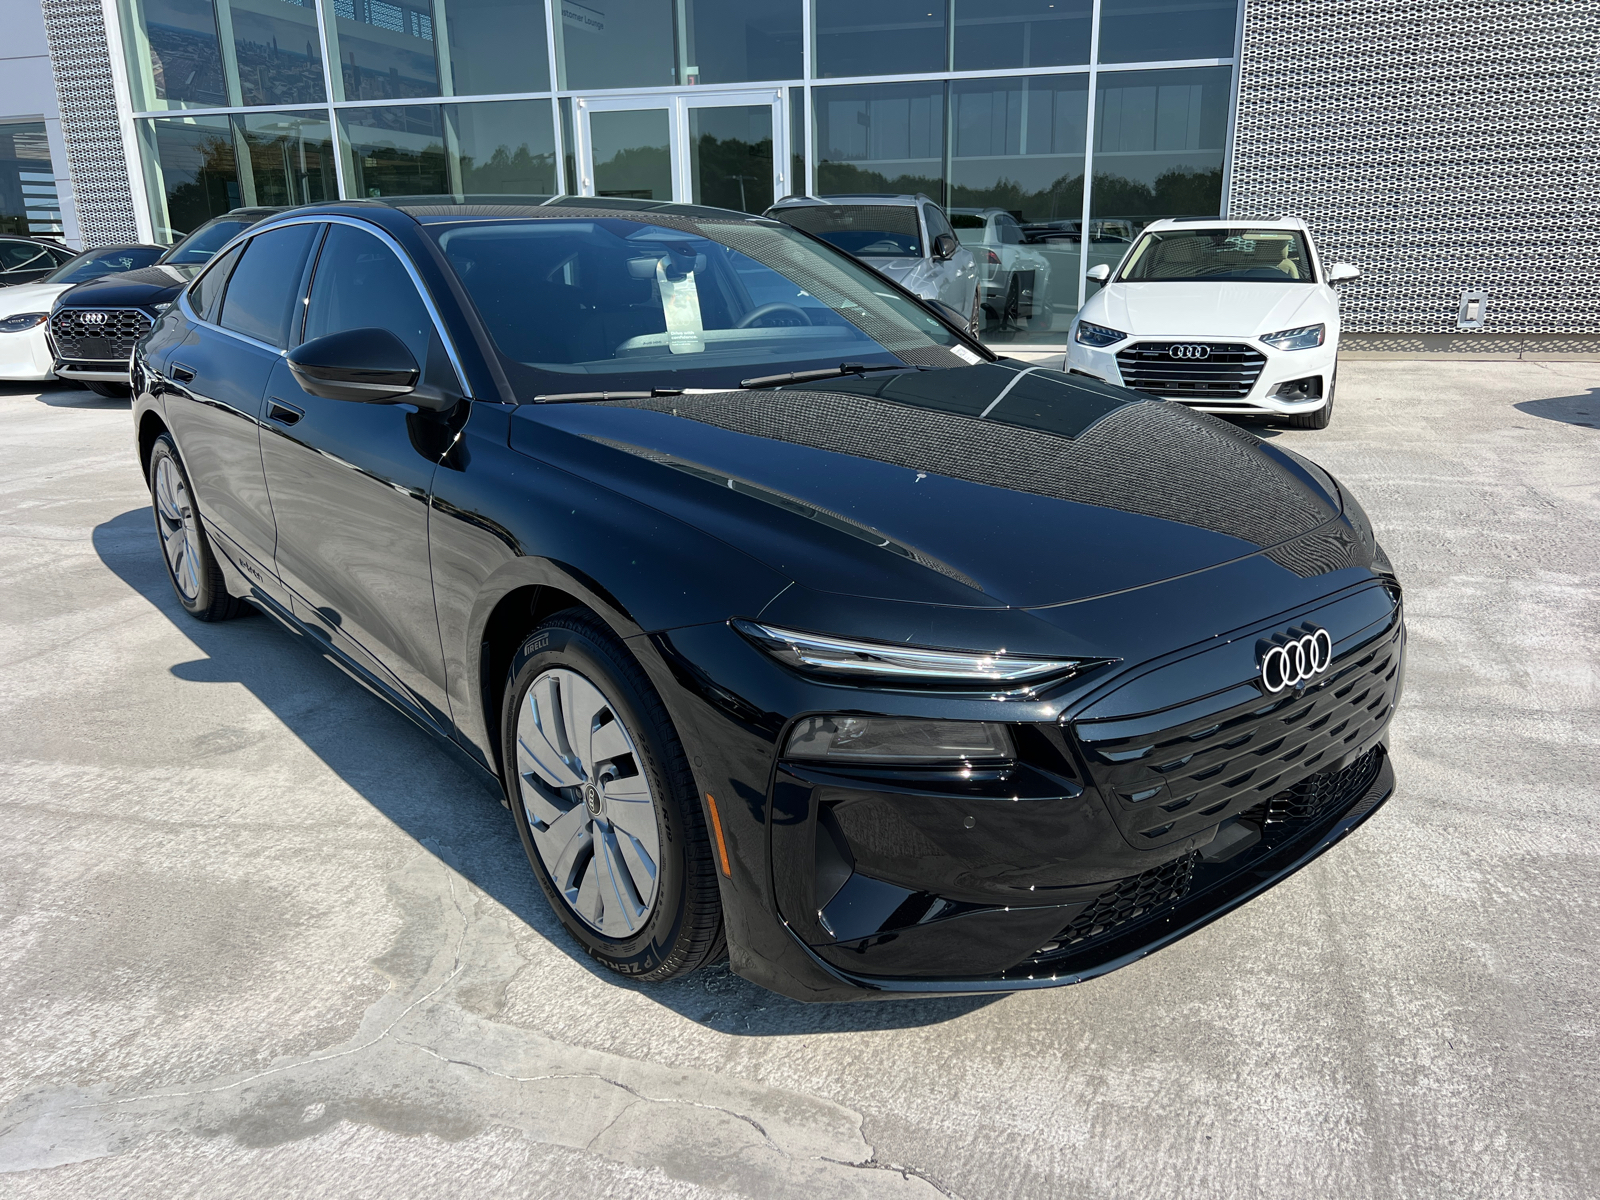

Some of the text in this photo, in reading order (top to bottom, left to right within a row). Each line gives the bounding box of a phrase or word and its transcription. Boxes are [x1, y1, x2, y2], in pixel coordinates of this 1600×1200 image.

[561, 9, 604, 31] stomer Lounge
[239, 557, 264, 583] e-tron
[524, 632, 550, 657] PIRELLI
[637, 732, 666, 803] 225/55
[661, 806, 674, 844] R19
[661, 762, 676, 802] OUTSIDE
[644, 954, 653, 969] P
